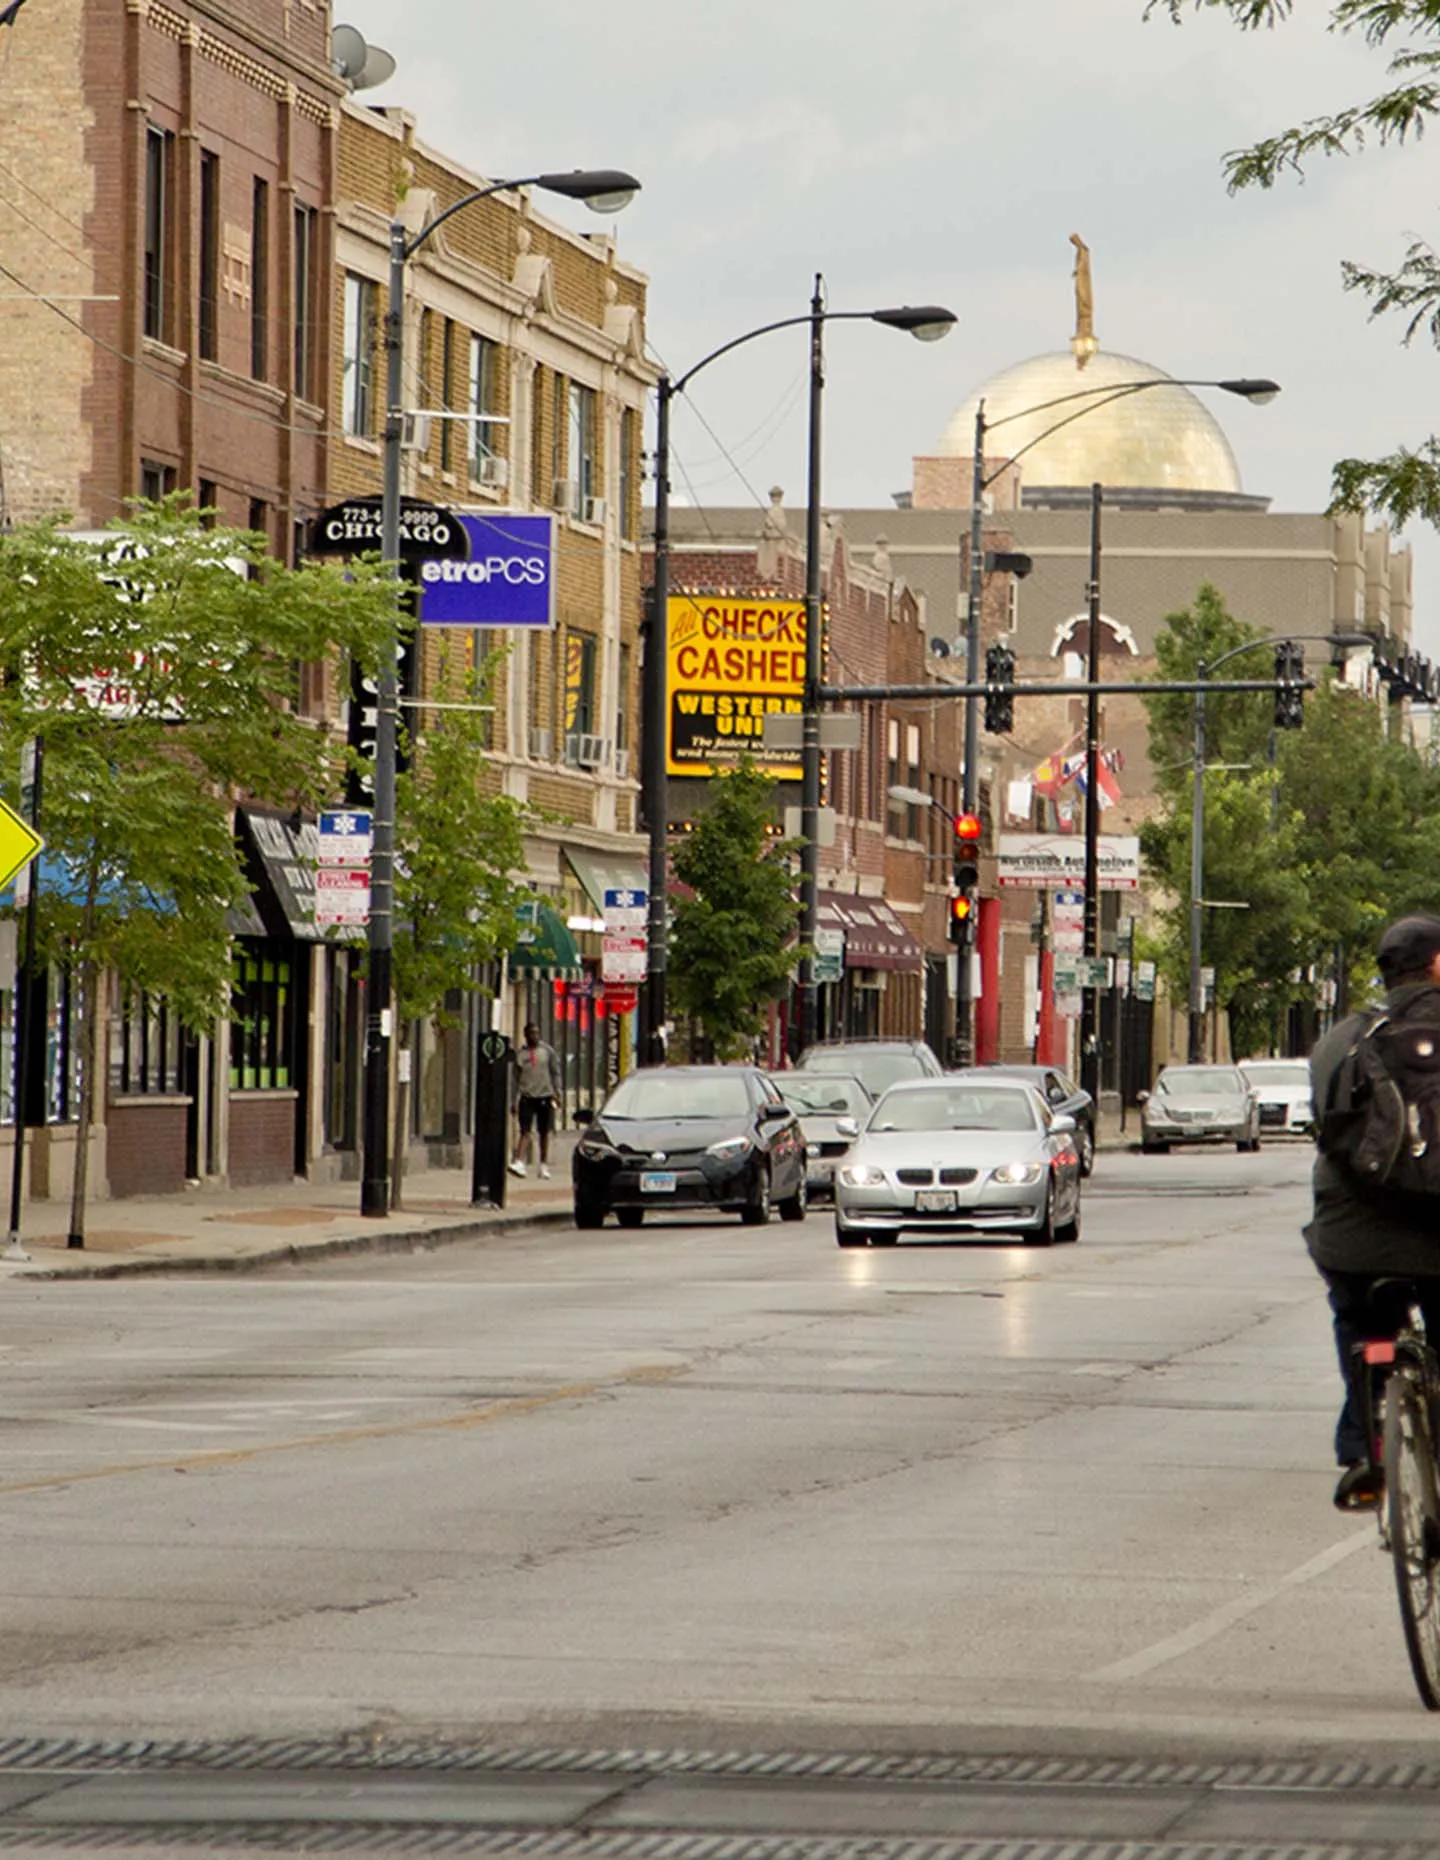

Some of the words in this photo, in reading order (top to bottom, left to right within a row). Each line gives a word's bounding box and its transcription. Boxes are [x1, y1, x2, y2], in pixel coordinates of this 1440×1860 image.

[342, 508, 439, 525] 773-4-9999
[421, 557, 545, 584] etroPCS
[702, 607, 806, 644] CHECKS
[677, 646, 806, 682] CASHED
[677, 694, 803, 715] WESTERN
[717, 716, 764, 735] UNI
